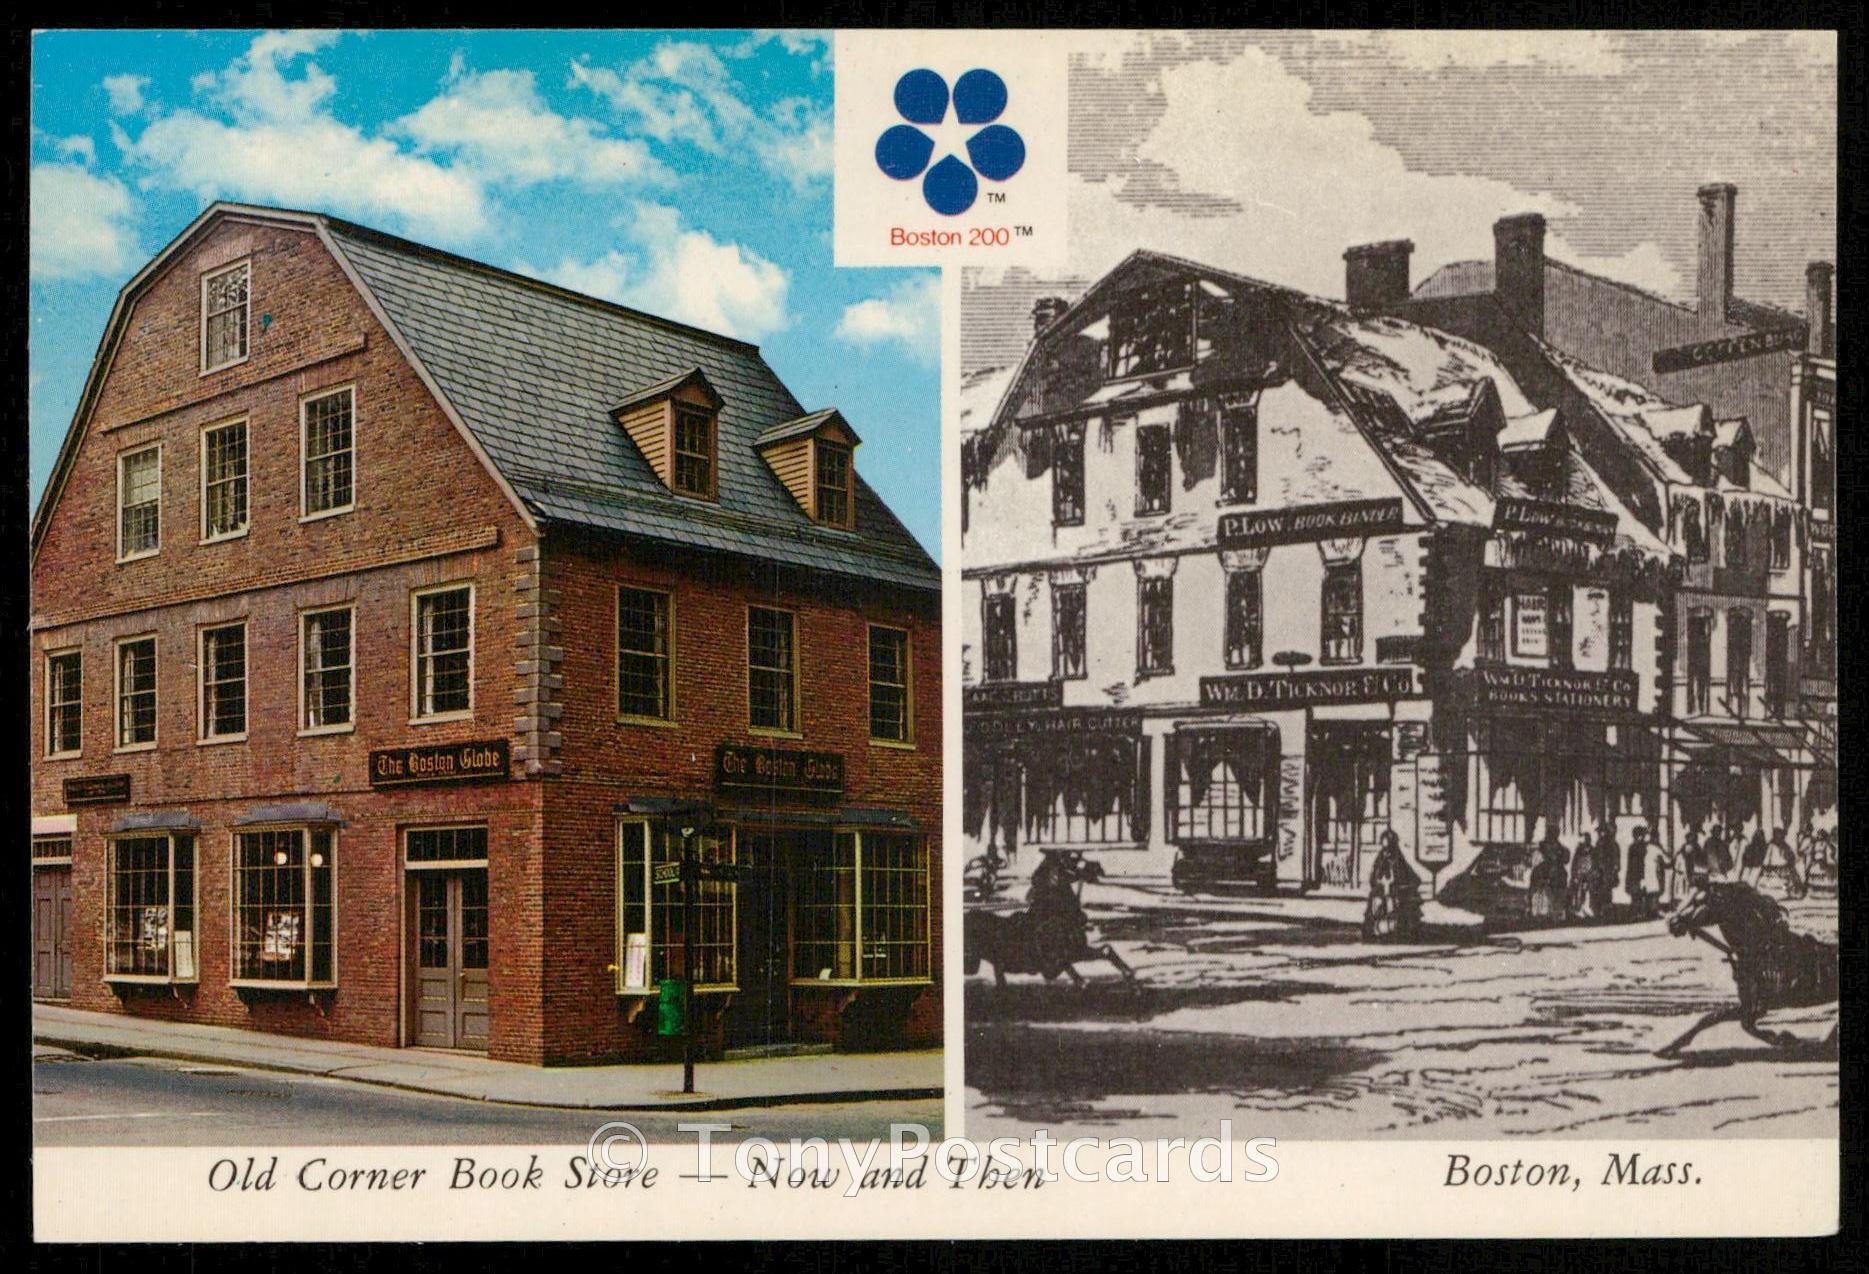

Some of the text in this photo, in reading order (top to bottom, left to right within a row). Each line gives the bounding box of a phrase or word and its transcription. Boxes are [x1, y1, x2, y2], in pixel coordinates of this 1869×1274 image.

[987, 192, 1006, 203] TM
[890, 227, 962, 246] Boston
[969, 227, 1010, 246] 200
[1294, 513, 1336, 530] BOOK
[377, 747, 500, 776] The Boston Globe
[208, 1156, 278, 1192] Old
[297, 1157, 427, 1191] Corner
[450, 1154, 544, 1190] Book
[564, 1155, 659, 1189] Store
[748, 1155, 840, 1190] Now
[859, 1154, 928, 1190] and
[946, 1154, 1046, 1190] Then
[1444, 1152, 1701, 1192] Boston, Mass.
